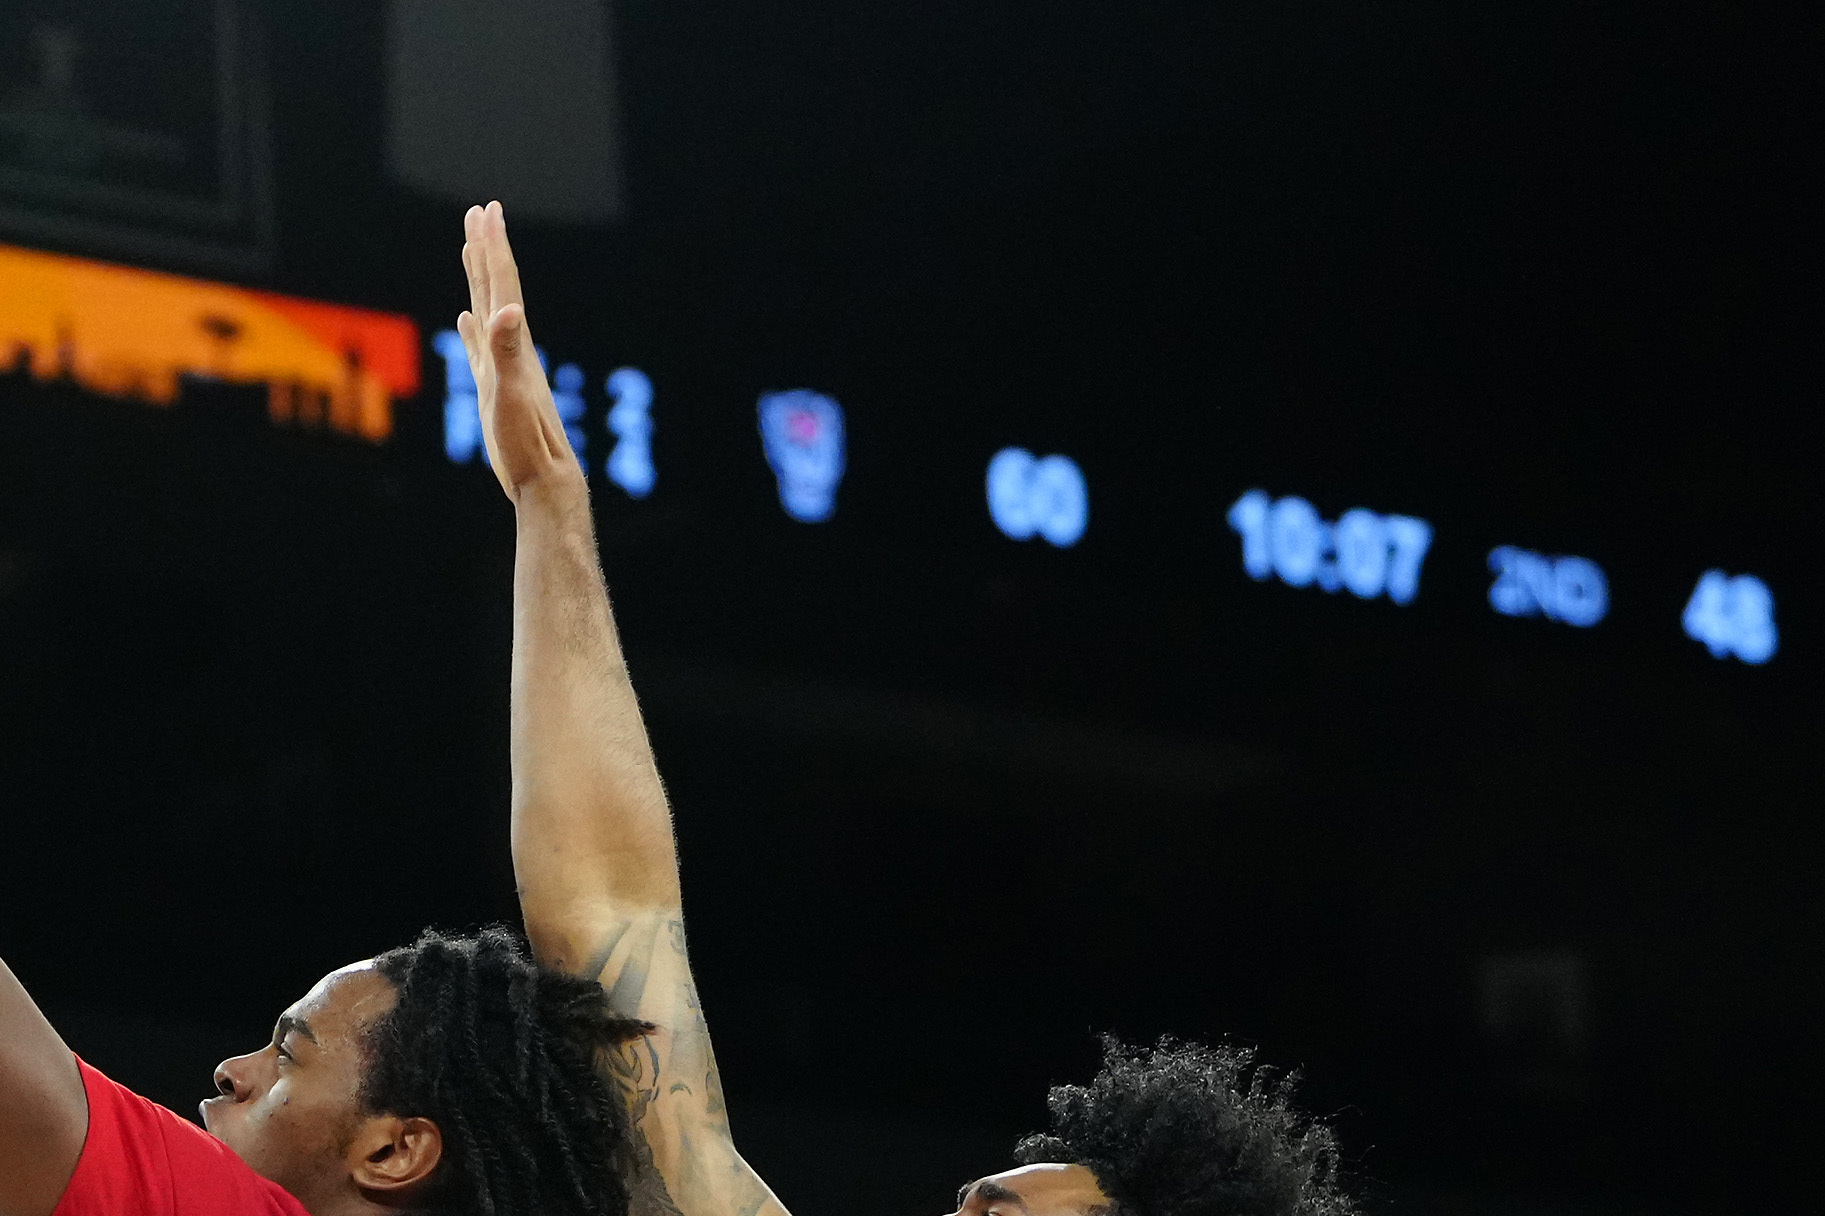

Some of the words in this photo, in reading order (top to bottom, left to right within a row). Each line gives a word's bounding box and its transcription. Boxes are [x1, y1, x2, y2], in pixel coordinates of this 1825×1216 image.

[986, 446, 1088, 548] 60
[1227, 489, 1435, 606] 10:07
[1681, 567, 1779, 665] 48
